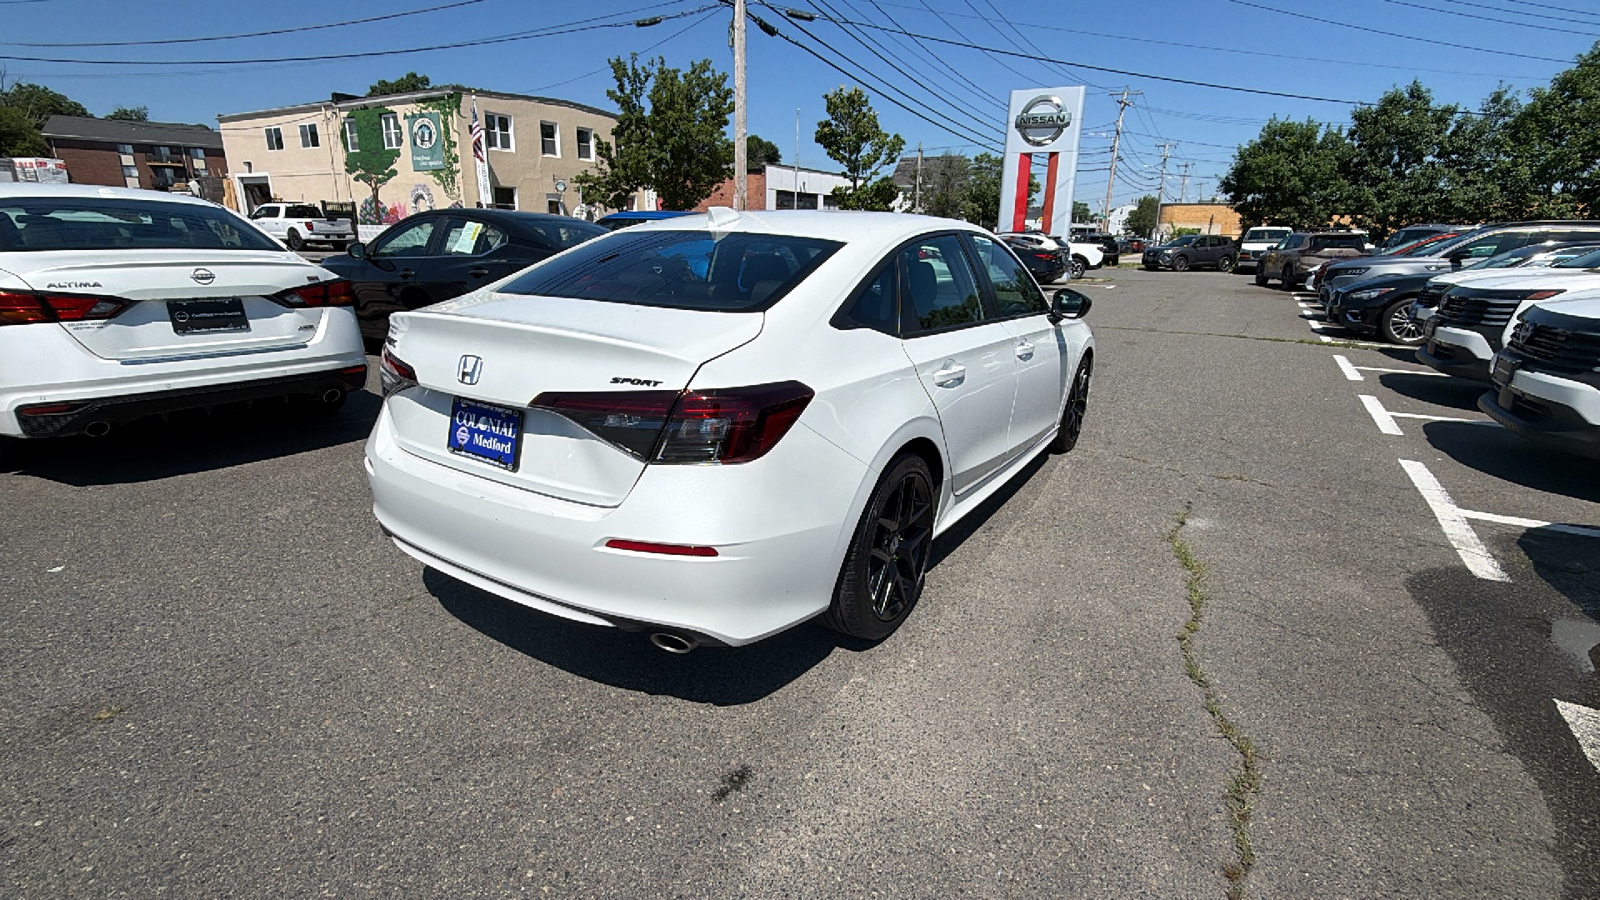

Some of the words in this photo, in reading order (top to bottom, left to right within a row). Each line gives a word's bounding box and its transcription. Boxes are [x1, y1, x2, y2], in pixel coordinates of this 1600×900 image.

[1020, 114, 1066, 125] NISSAN
[47, 281, 103, 289] ALTIMA
[609, 376, 664, 388] SPORT
[456, 410, 517, 439] COLONIAL
[473, 432, 512, 454] Medford
